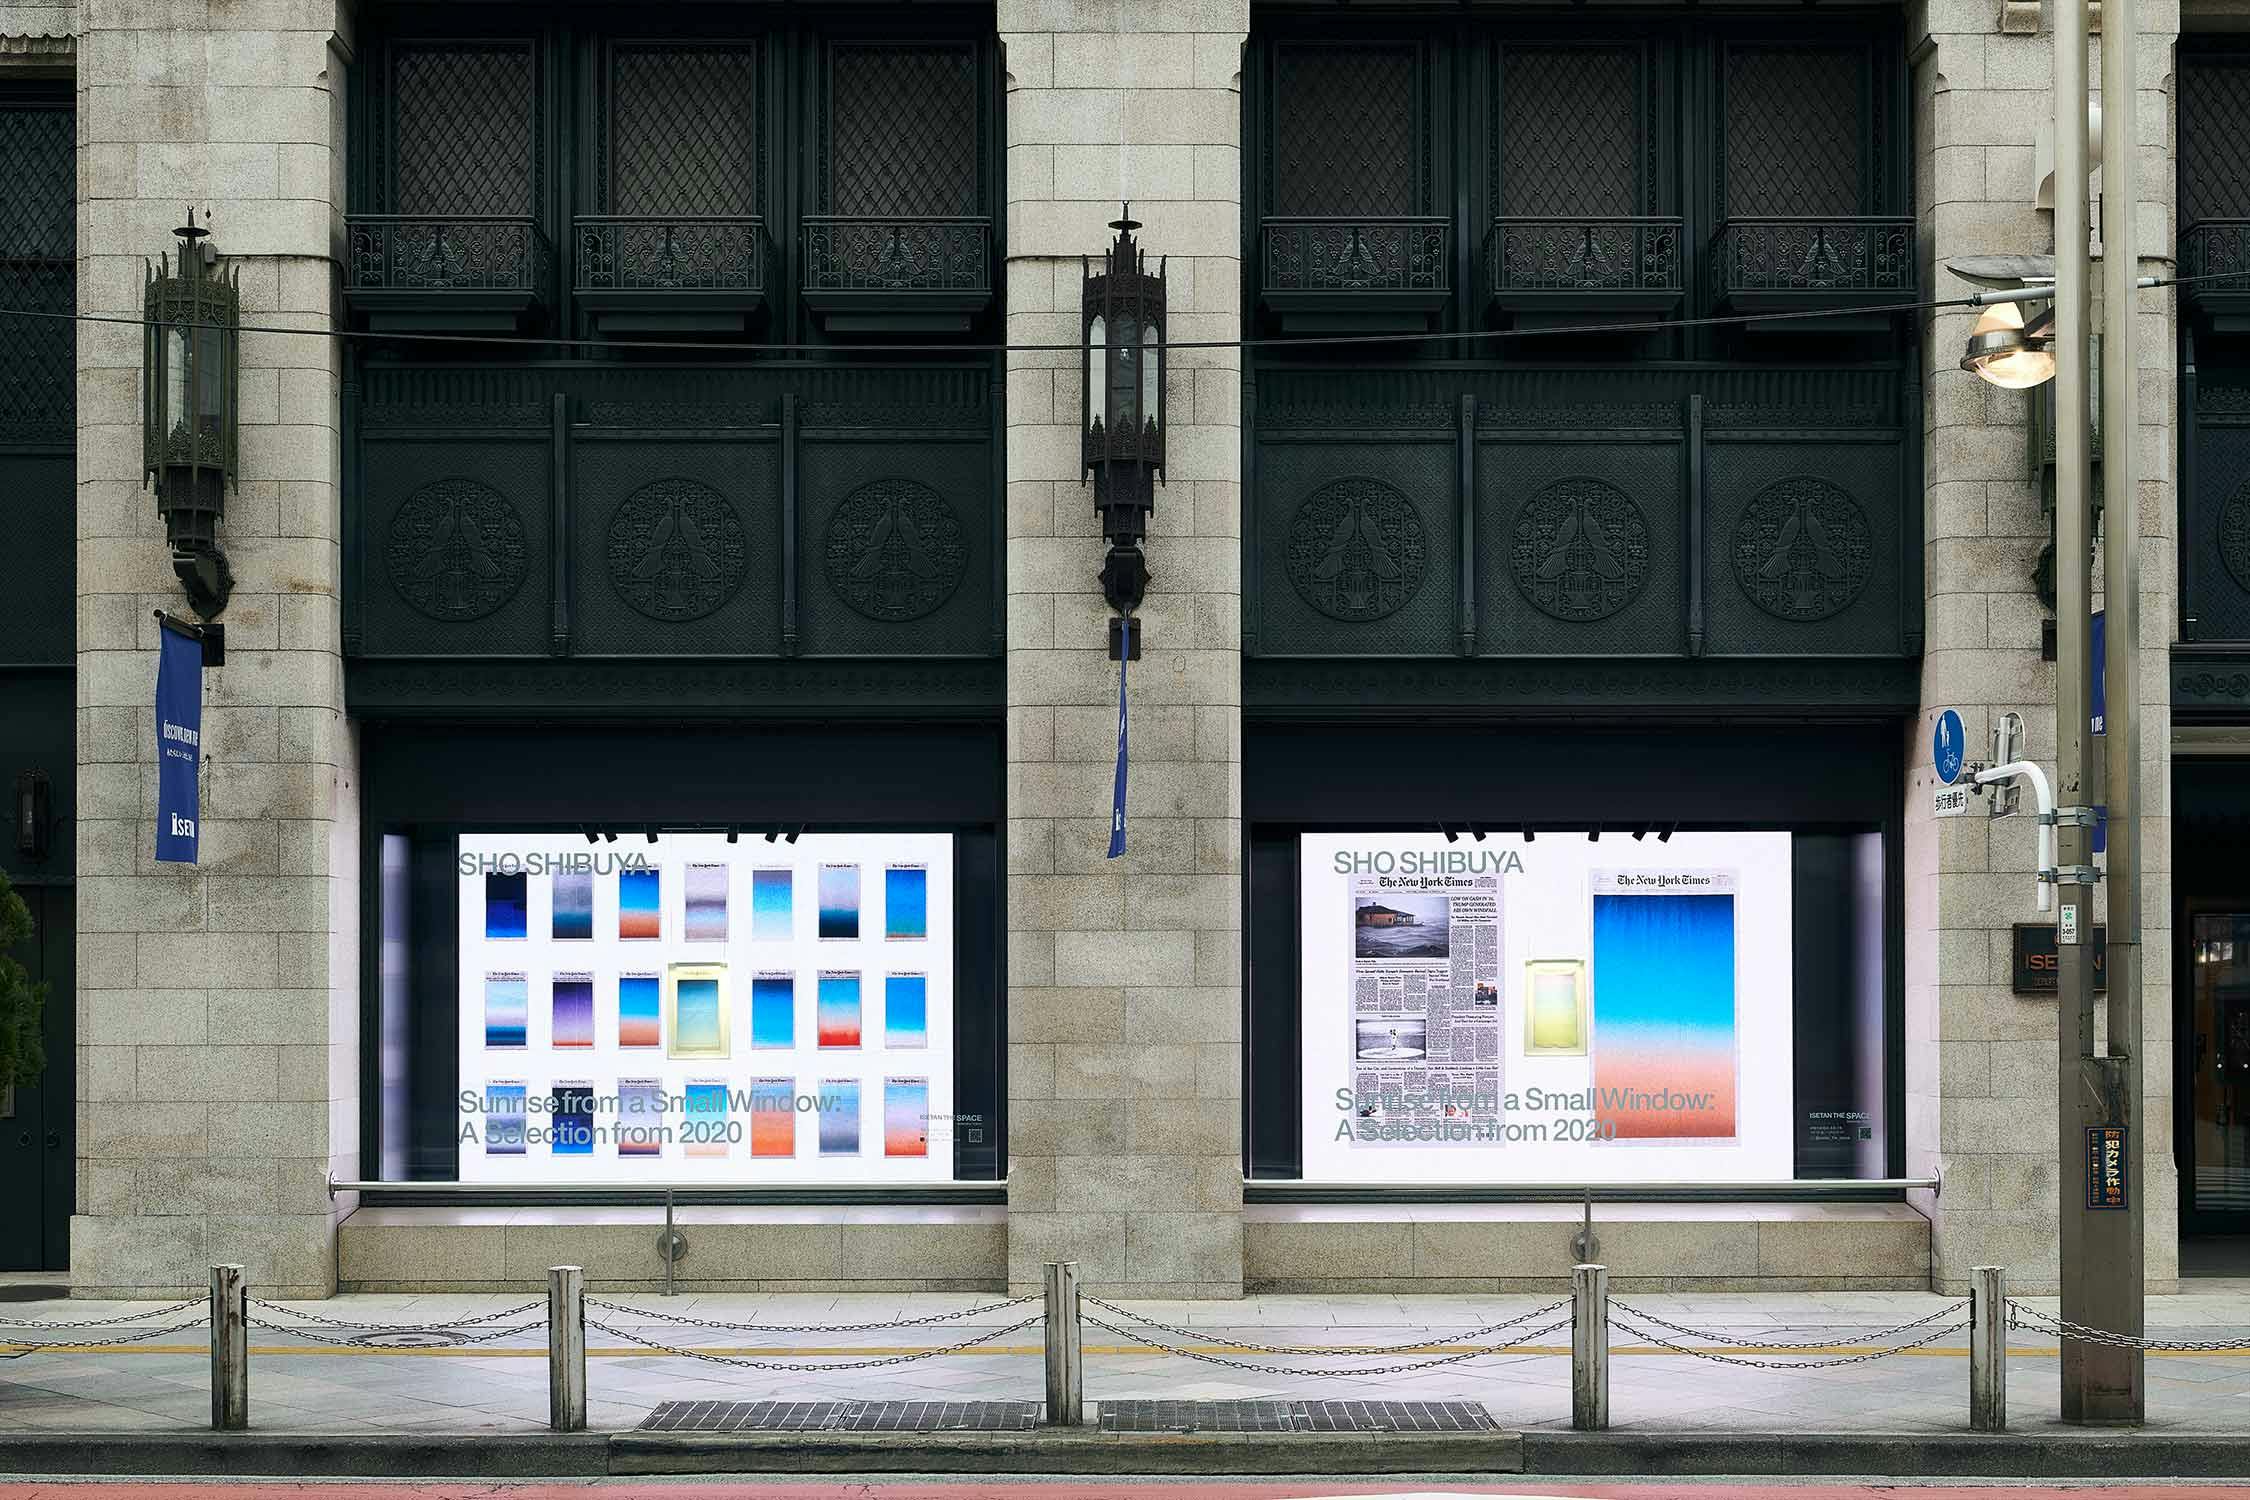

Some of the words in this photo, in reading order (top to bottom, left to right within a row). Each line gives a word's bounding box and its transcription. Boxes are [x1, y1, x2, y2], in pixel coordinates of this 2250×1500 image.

[1935, 791, 1964, 811] 歩行者優先
[459, 852, 521, 876] SHO
[525, 852, 651, 876] SHIBUYA
[1334, 850, 1396, 874] SHO
[1399, 850, 1524, 874] SHIBUYA
[1379, 876, 1397, 888] The
[1398, 876, 1419, 887] New
[1420, 876, 1443, 889] York
[1444, 876, 1473, 887] Times
[1617, 874, 1635, 886] The
[1636, 874, 1657, 885] New
[1657, 874, 1680, 887] York
[1681, 874, 1711, 885] Times
[459, 1090, 559, 1113] Sunrise
[561, 1090, 623, 1113] from
[628, 1096, 646, 1113] a
[650, 1089, 723, 1113] Small
[1335, 1088, 1435, 1111] Sunrise
[1503, 1092, 1521, 1111] a
[1524, 1087, 1597, 1111] Small
[1600, 1087, 1715, 1111] Window:
[459, 1121, 479, 1145] A
[485, 1121, 607, 1145] Selection
[611, 1121, 673, 1143] from
[679, 1120, 742, 1144] 2020
[1334, 1119, 1355, 1142] A
[1553, 1119, 1617, 1142] 2020
